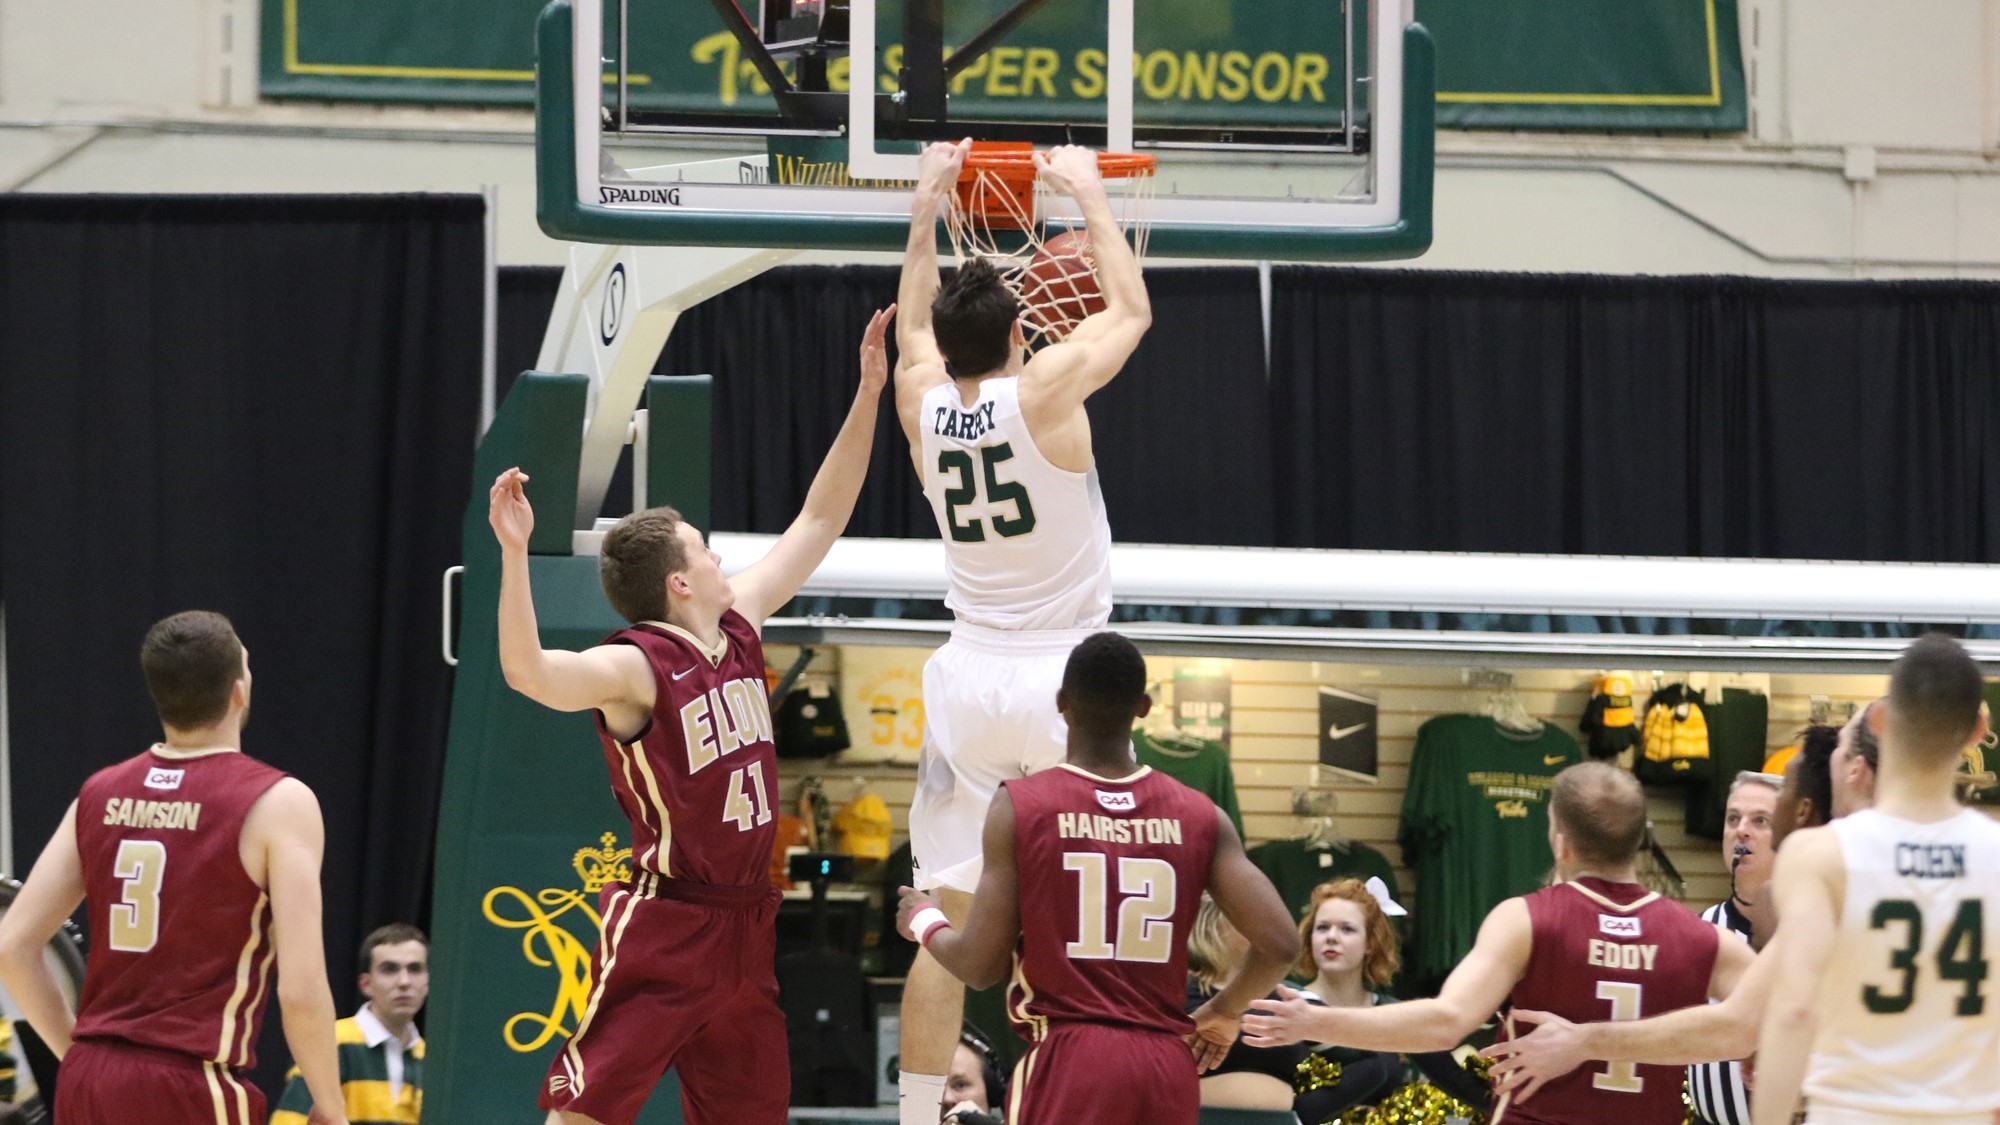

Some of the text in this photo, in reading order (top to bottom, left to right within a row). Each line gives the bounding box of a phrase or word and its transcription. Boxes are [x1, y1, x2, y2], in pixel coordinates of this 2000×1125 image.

[880, 44, 1060, 97] SPER
[1071, 48, 1329, 102] SONSOR
[599, 186, 680, 206] SPALDING
[935, 400, 996, 441] TARRY
[938, 441, 1037, 543] 25
[680, 677, 775, 776] ELON
[151, 773, 178, 785] CAA
[722, 760, 773, 833] 41
[1100, 794, 1131, 806] CAA
[103, 797, 202, 831] SAMSON
[1057, 812, 1183, 845] HAIRSTON
[109, 839, 167, 953] 3
[1062, 852, 1177, 963] 12
[1604, 919, 1636, 932] CAA
[1588, 938, 1659, 971] EDDY
[1861, 898, 1989, 1017] 34
[1592, 980, 1645, 1093] 1
